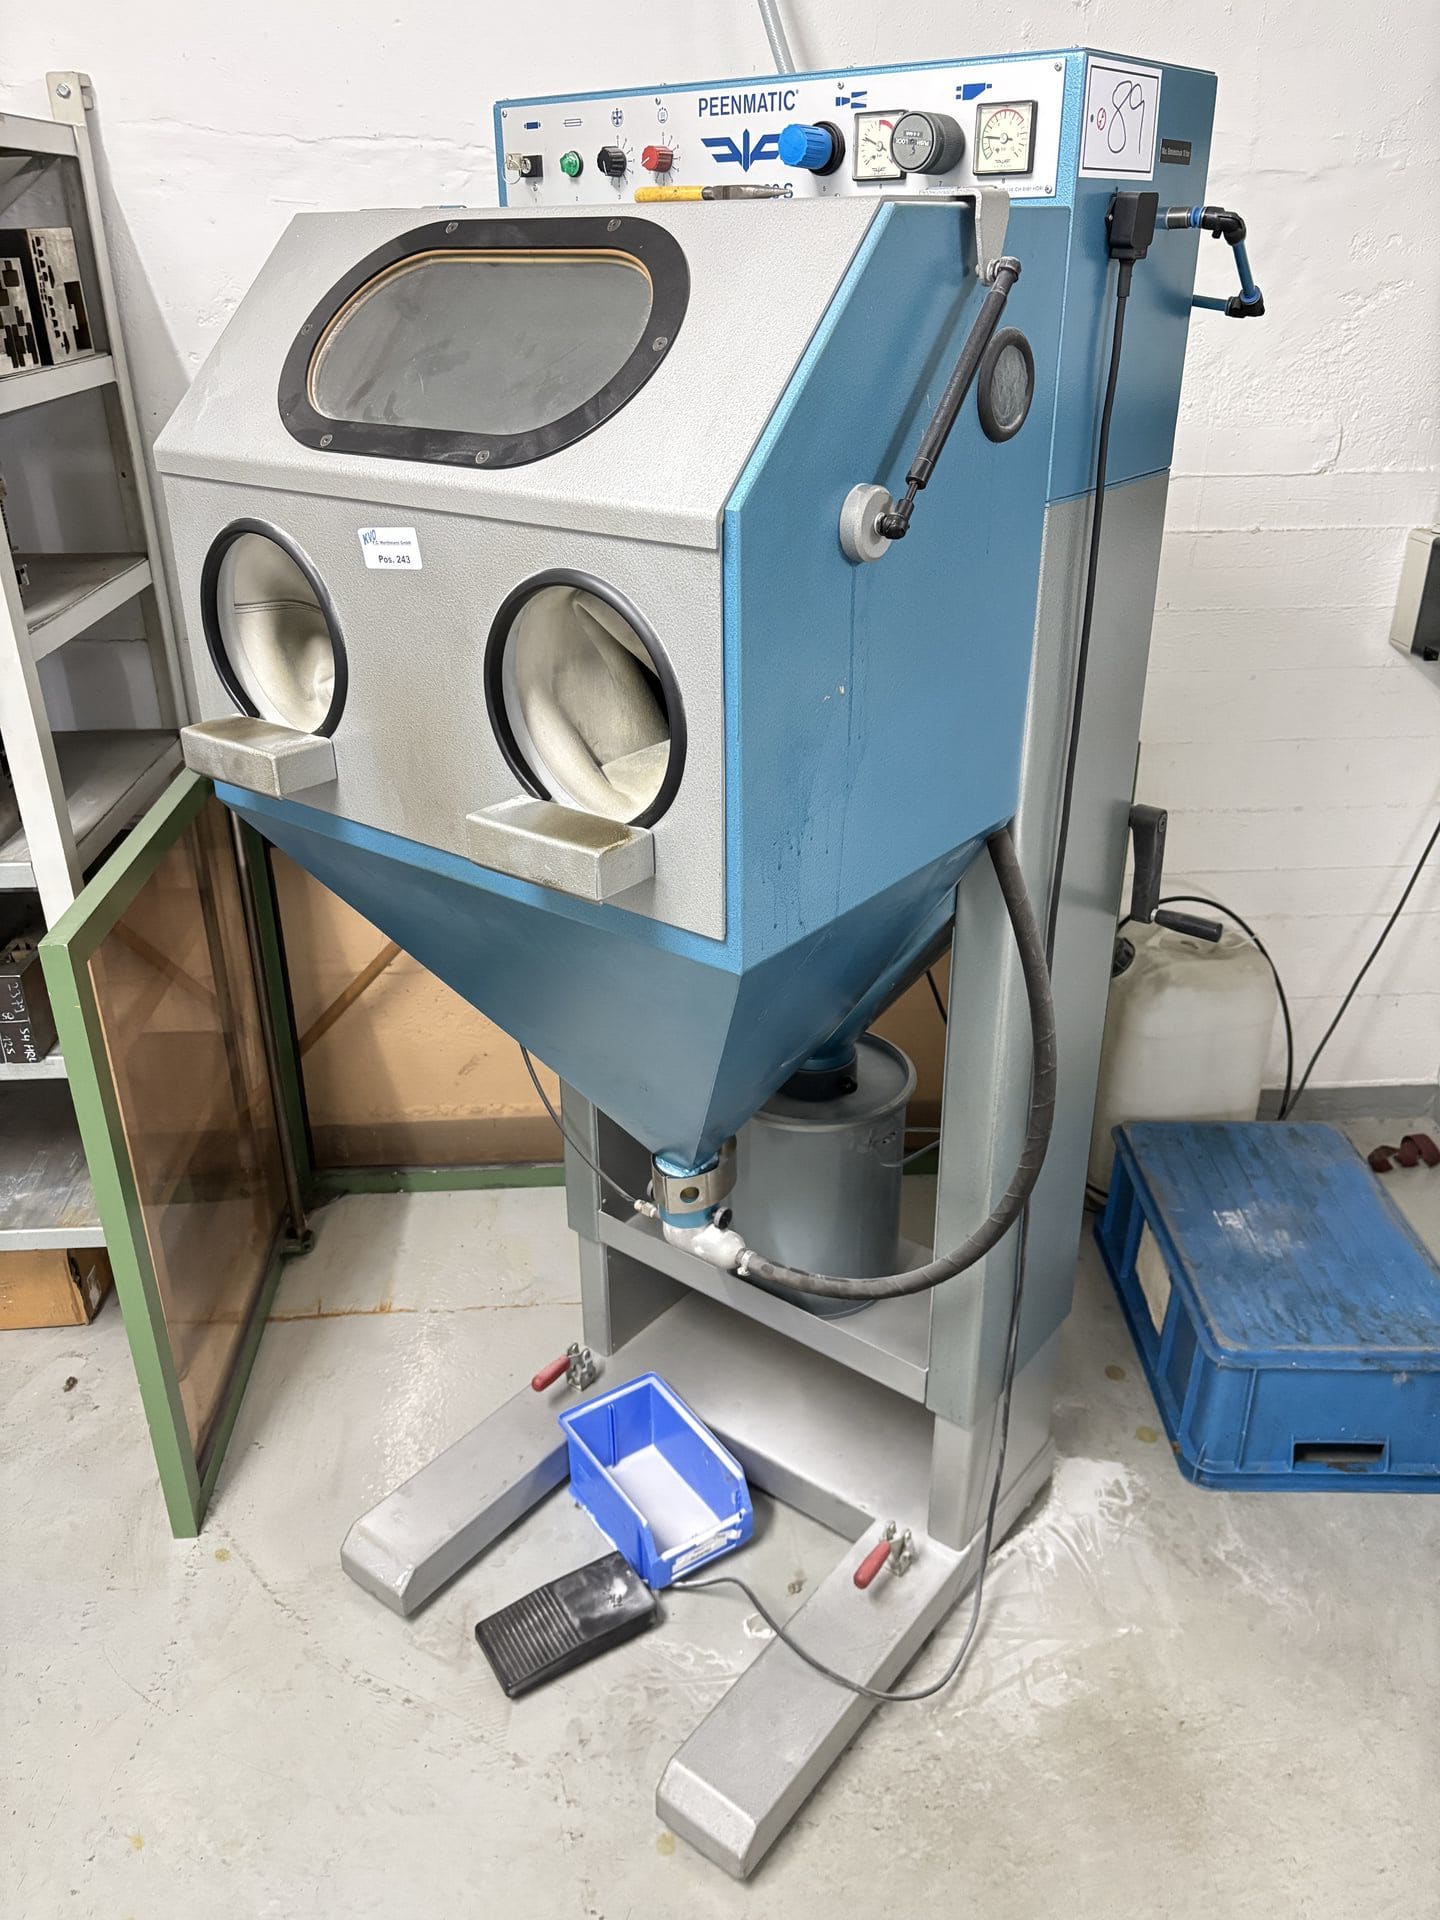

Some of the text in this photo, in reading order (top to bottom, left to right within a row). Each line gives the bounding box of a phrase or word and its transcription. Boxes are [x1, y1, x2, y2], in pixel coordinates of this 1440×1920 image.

[698, 89, 796, 118] PEENMATIC
[1107, 80, 1146, 155] 89
[378, 554, 411, 564] Pos. 243
